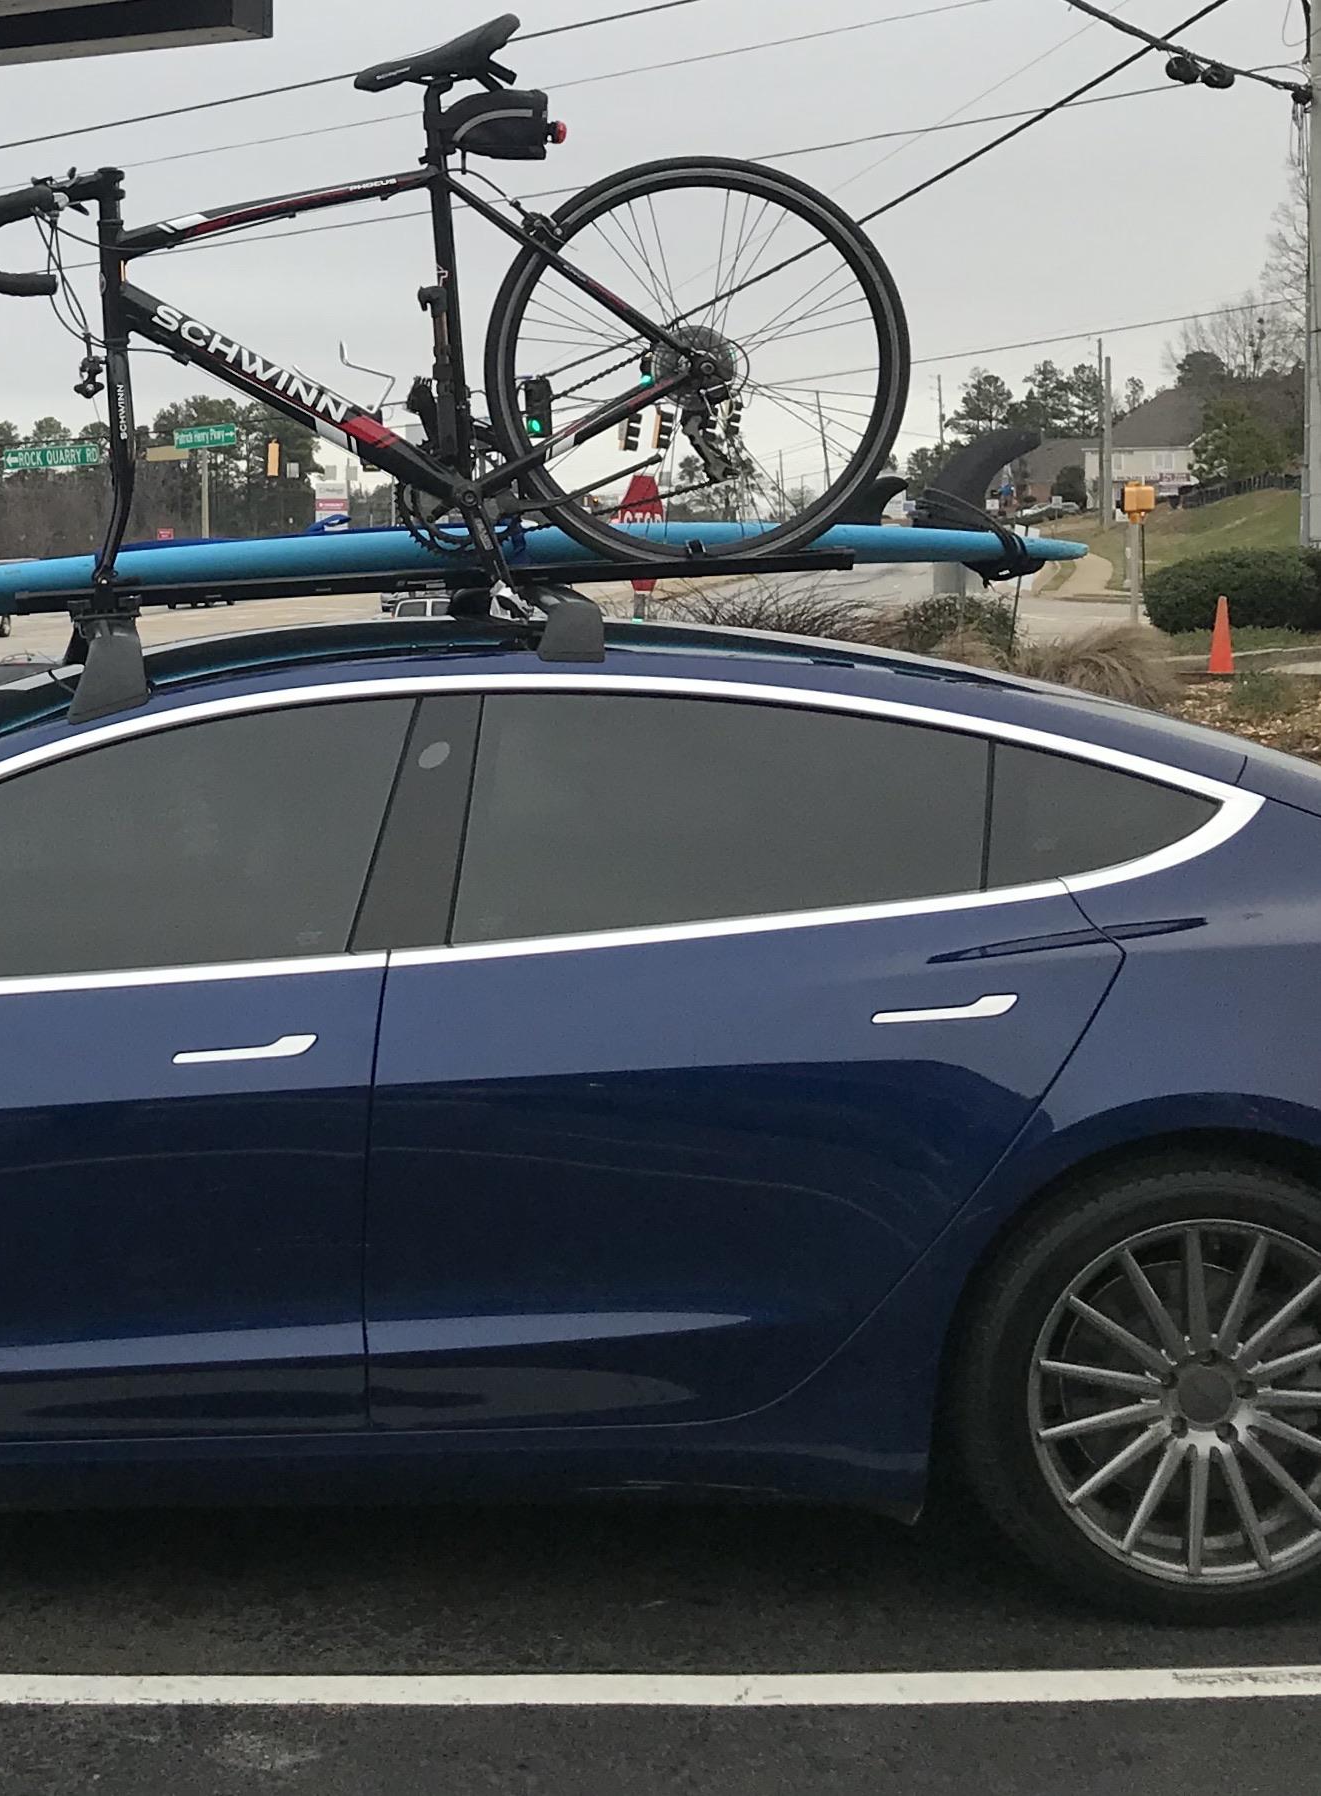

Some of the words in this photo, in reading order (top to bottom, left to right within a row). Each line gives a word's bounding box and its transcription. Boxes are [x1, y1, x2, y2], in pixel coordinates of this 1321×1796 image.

[349, 178, 397, 191] PHOCUS
[151, 304, 353, 423] SCHWINN
[116, 384, 128, 440] SCHWINN
[18, 451, 43, 467] ROCK
[46, 447, 82, 465] QUARRY
[86, 447, 98, 463] RD
